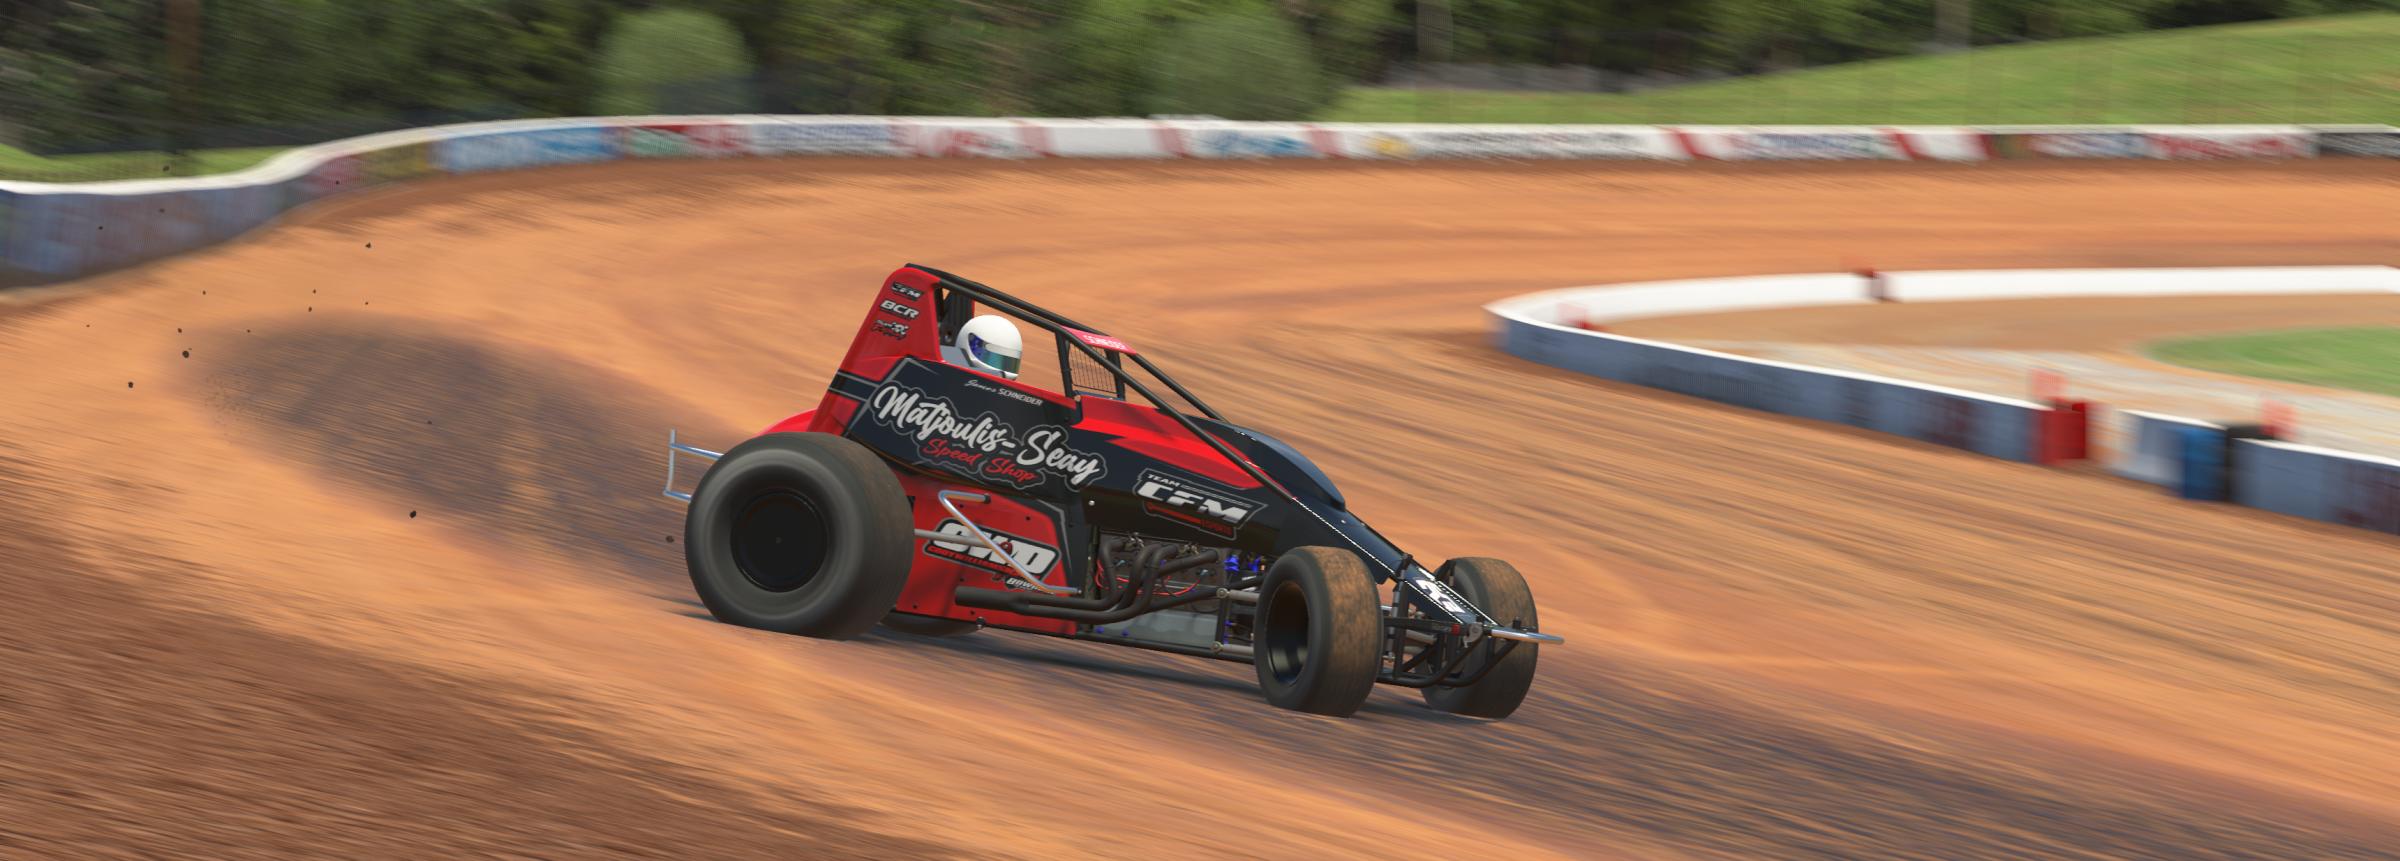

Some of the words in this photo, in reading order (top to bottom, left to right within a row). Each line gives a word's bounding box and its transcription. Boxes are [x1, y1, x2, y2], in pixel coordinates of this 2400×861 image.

[880, 299, 919, 318] BCR
[998, 388, 1043, 406] SCHNEIDER
[923, 438, 984, 466] Speed
[985, 456, 1040, 483] Shop
[1147, 473, 1181, 487] TEAM
[1137, 481, 1249, 524] CFM
